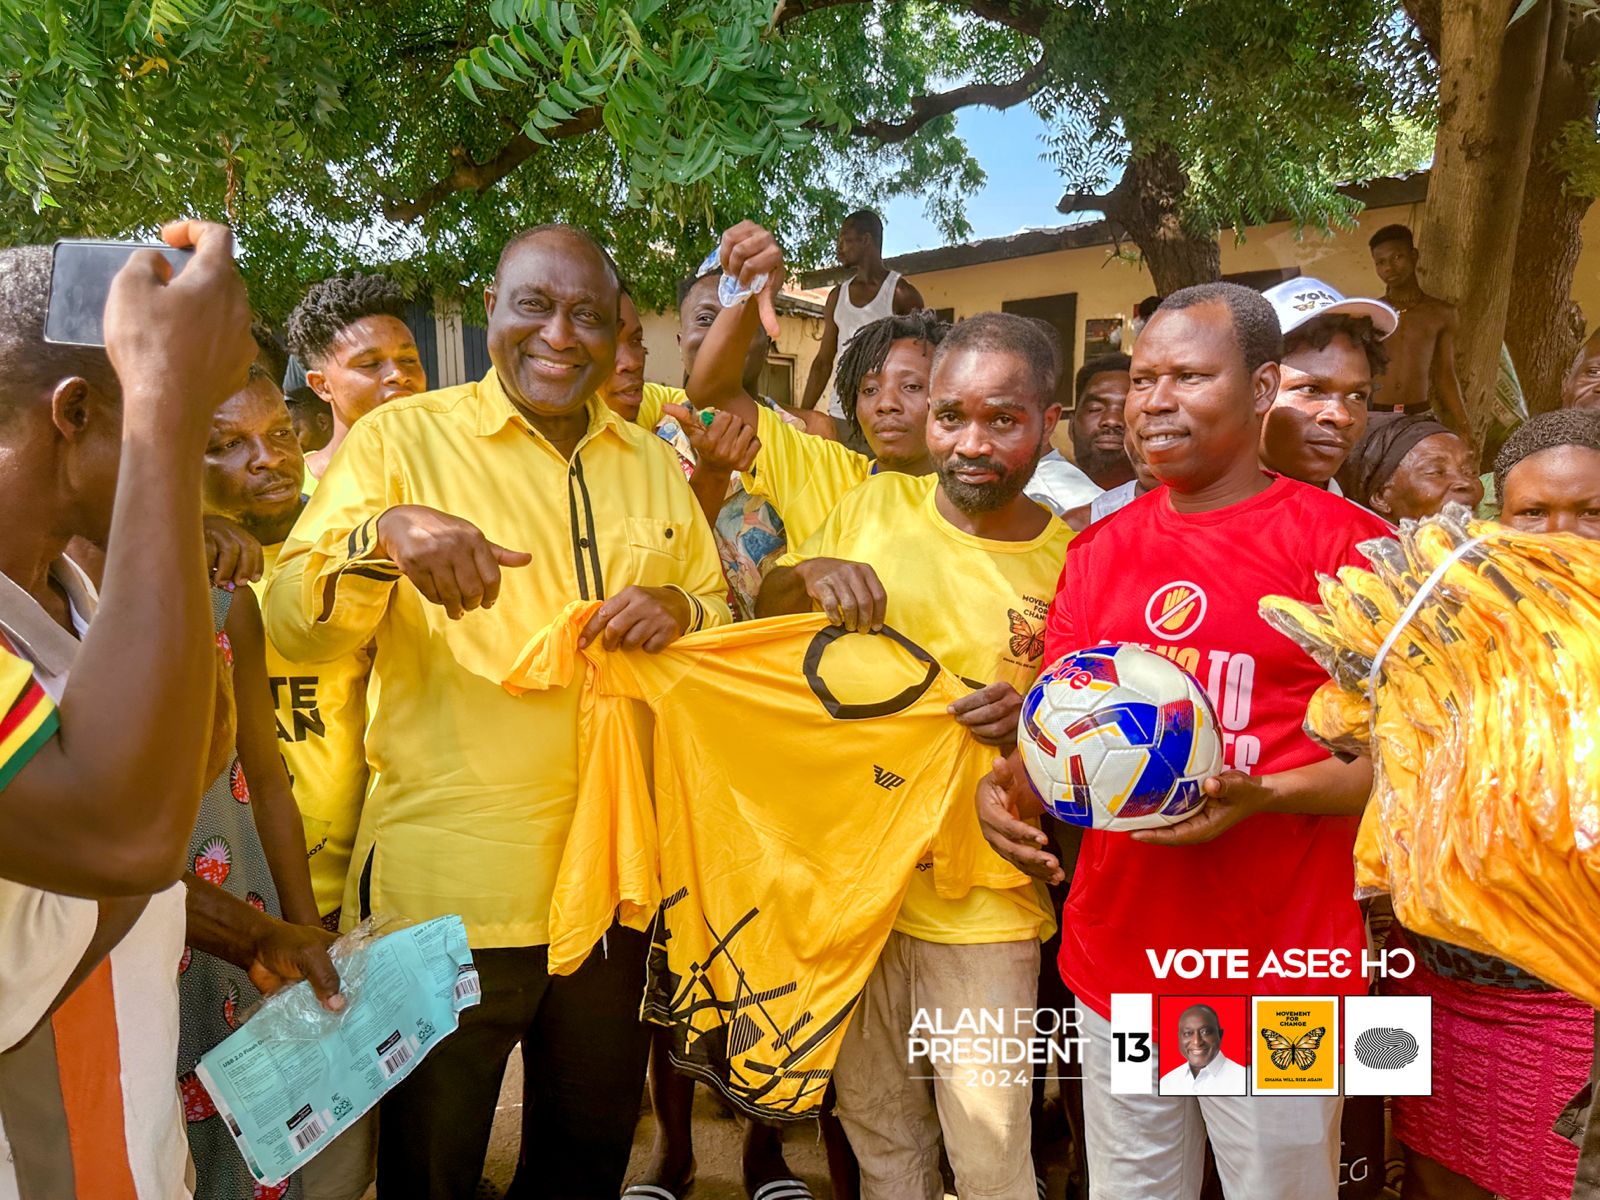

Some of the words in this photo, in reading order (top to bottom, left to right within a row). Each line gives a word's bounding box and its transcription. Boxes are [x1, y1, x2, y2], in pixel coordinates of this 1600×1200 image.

[1022, 594, 1050, 608] MOVEM
[1023, 609, 1047, 620] CHAN
[1047, 658, 1093, 690] tre
[1207, 649, 1256, 731] TO
[268, 676, 319, 709] TE
[275, 707, 326, 742] AN
